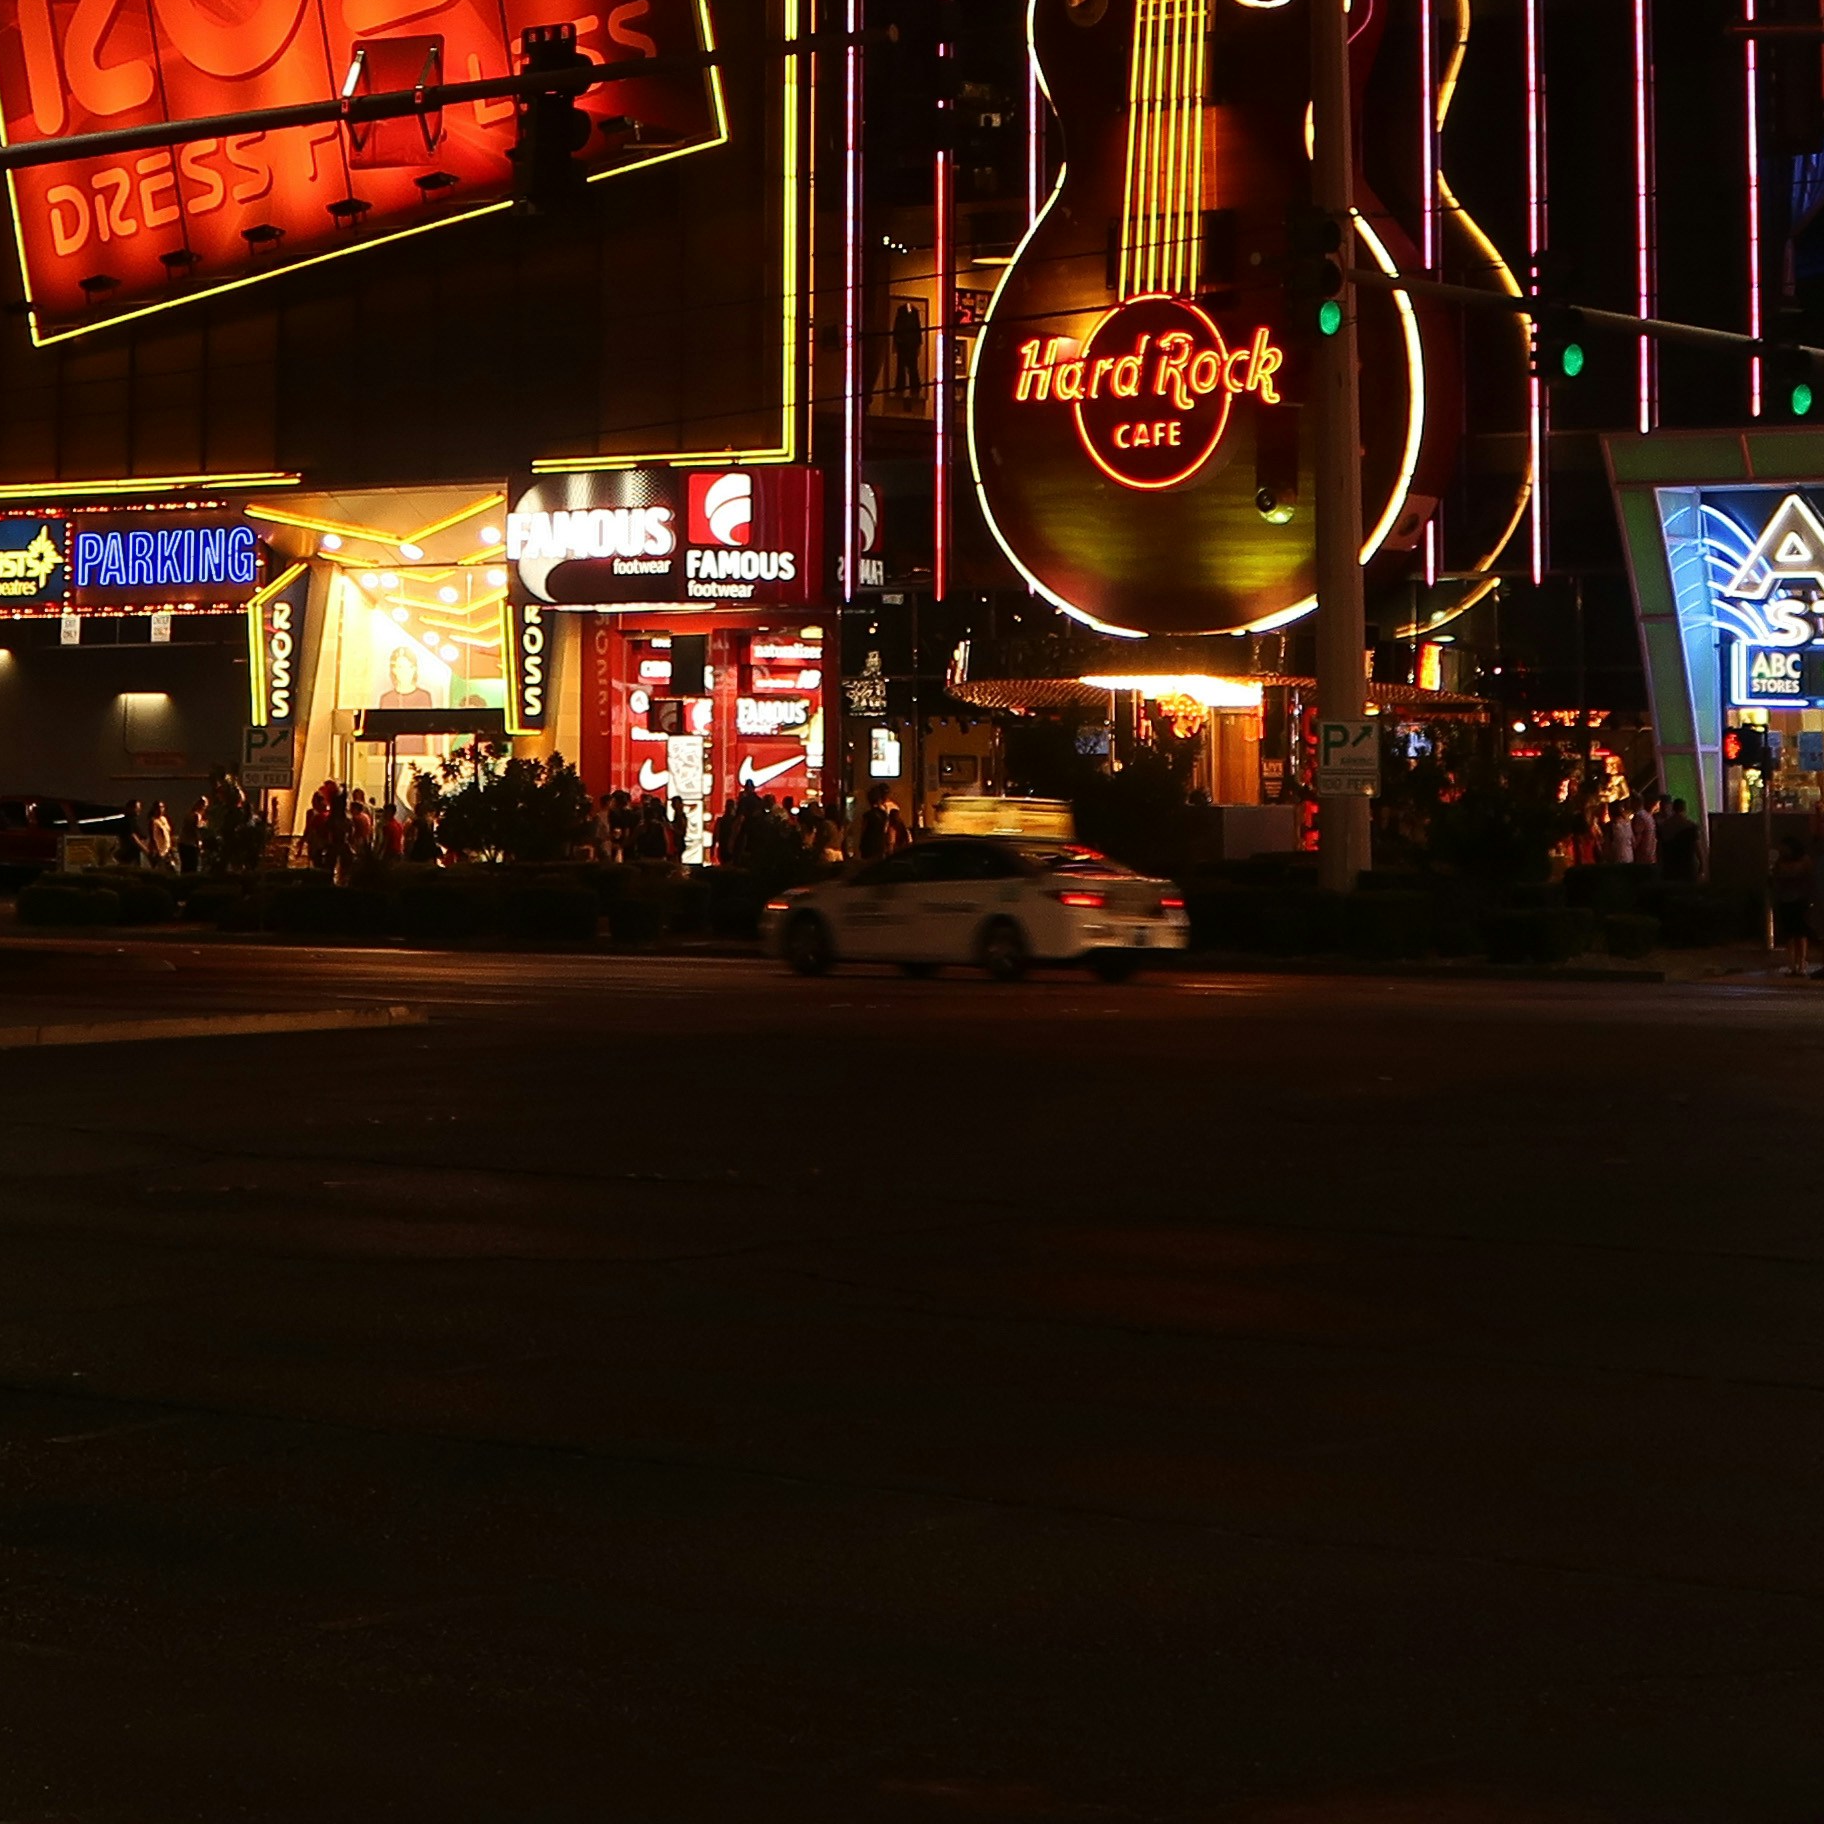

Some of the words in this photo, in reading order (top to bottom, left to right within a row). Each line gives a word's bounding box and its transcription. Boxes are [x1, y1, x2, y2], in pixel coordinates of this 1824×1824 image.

[47, 132, 274, 257] DRESS
[1016, 334, 1151, 401] Hard
[1154, 327, 1283, 410] Rock
[1114, 421, 1182, 449] CAFE
[507, 506, 676, 560] FAMOUS
[78, 526, 255, 586] PARKING
[613, 557, 672, 575] footwear
[686, 550, 795, 581] FAMOUS
[687, 579, 755, 599] footwear
[270, 602, 294, 719] ROSS
[522, 606, 544, 716] ROSS
[1752, 652, 1801, 677] ABC
[1752, 677, 1800, 694] STORES
[736, 698, 810, 726] FAMOUS
[247, 730, 268, 763] P
[1324, 725, 1349, 765] P
